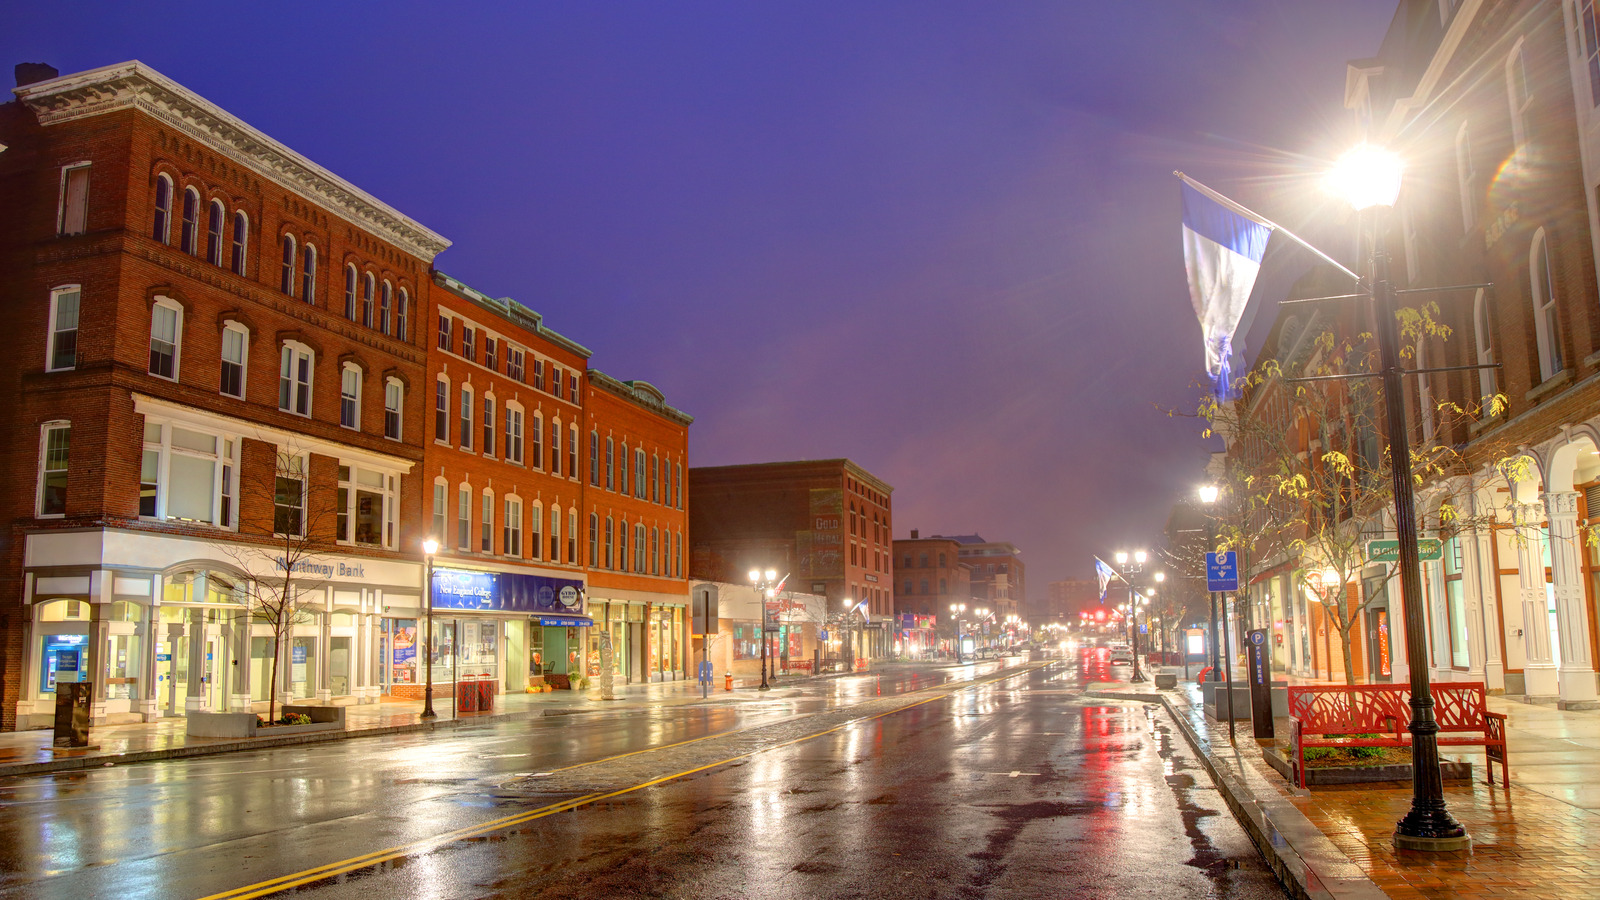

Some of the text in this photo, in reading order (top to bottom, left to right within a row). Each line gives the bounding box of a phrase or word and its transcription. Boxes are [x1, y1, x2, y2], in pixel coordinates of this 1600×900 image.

[276, 556, 364, 579] Northway Bank
[439, 583, 491, 599] New England College
[1255, 634, 1261, 643] P
